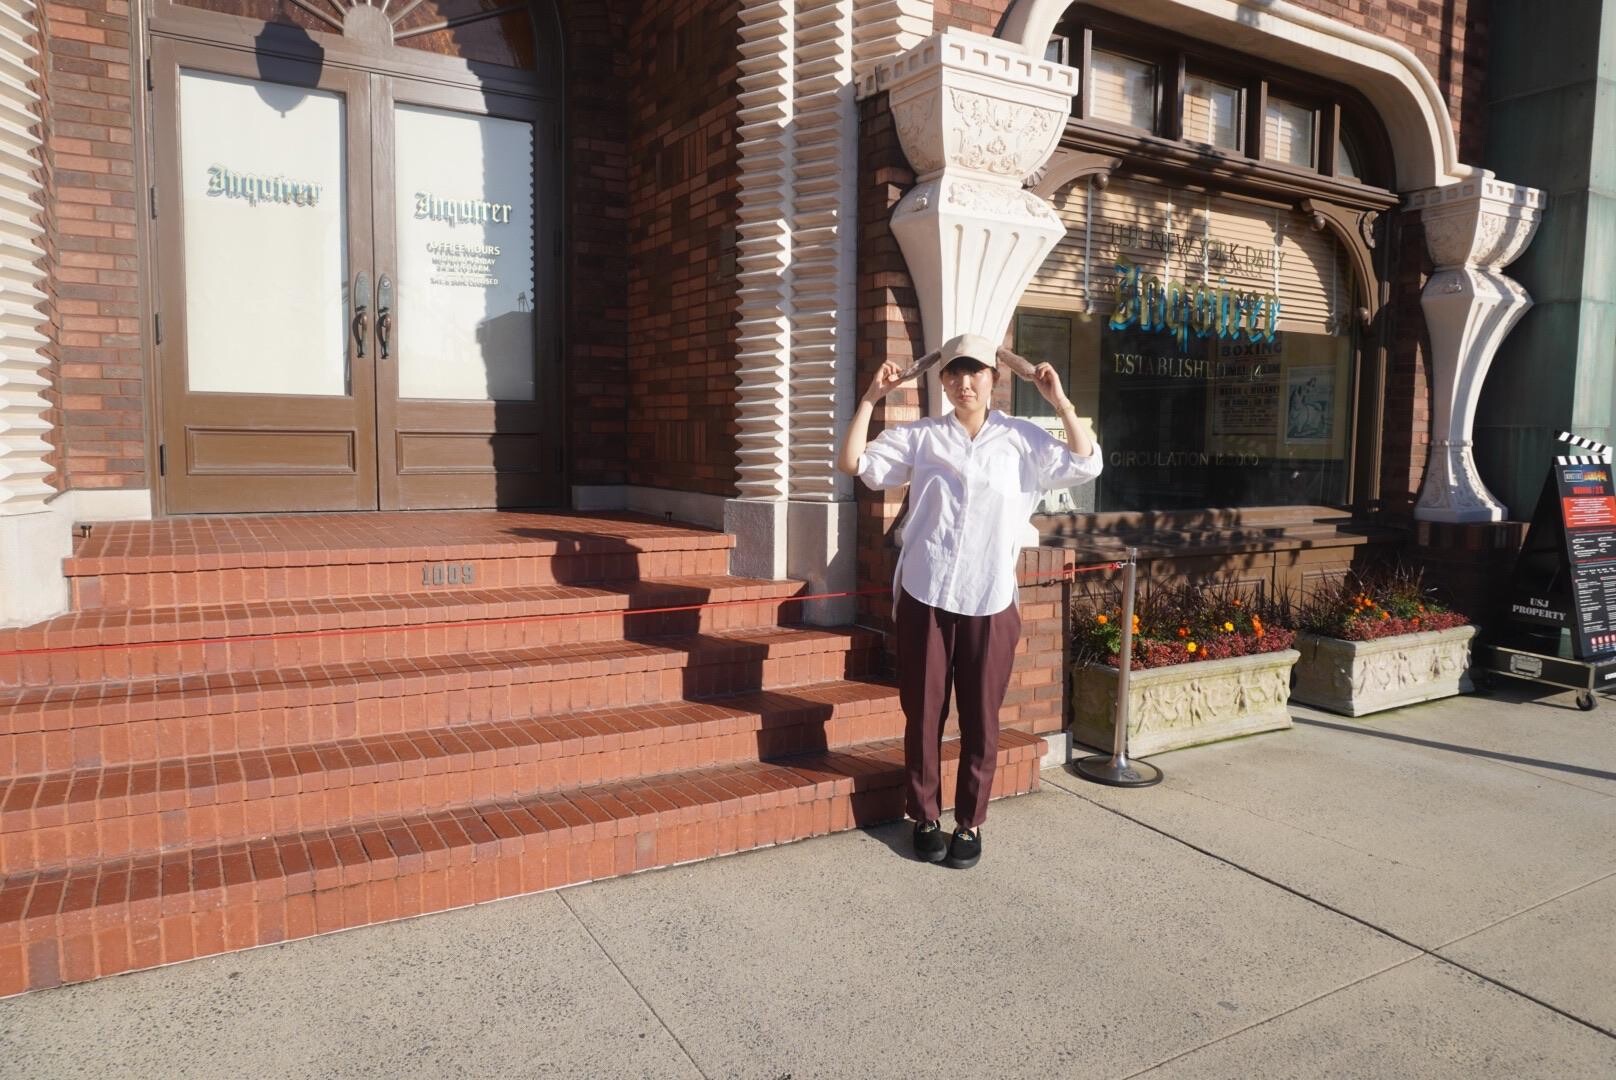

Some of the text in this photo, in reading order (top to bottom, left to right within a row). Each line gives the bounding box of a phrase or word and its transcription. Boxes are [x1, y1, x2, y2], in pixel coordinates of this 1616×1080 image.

[205, 163, 322, 207] Inquirer
[414, 190, 513, 227] Inquirer
[1150, 228, 1195, 254] NEW
[1245, 245, 1286, 271] DAILY
[1109, 255, 1281, 353] Inquirer
[1109, 450, 1209, 467] CIRCULATION
[421, 562, 475, 586] 1009
[1512, 604, 1566, 621] PROPERTY
[1529, 597, 1550, 608] USJ
